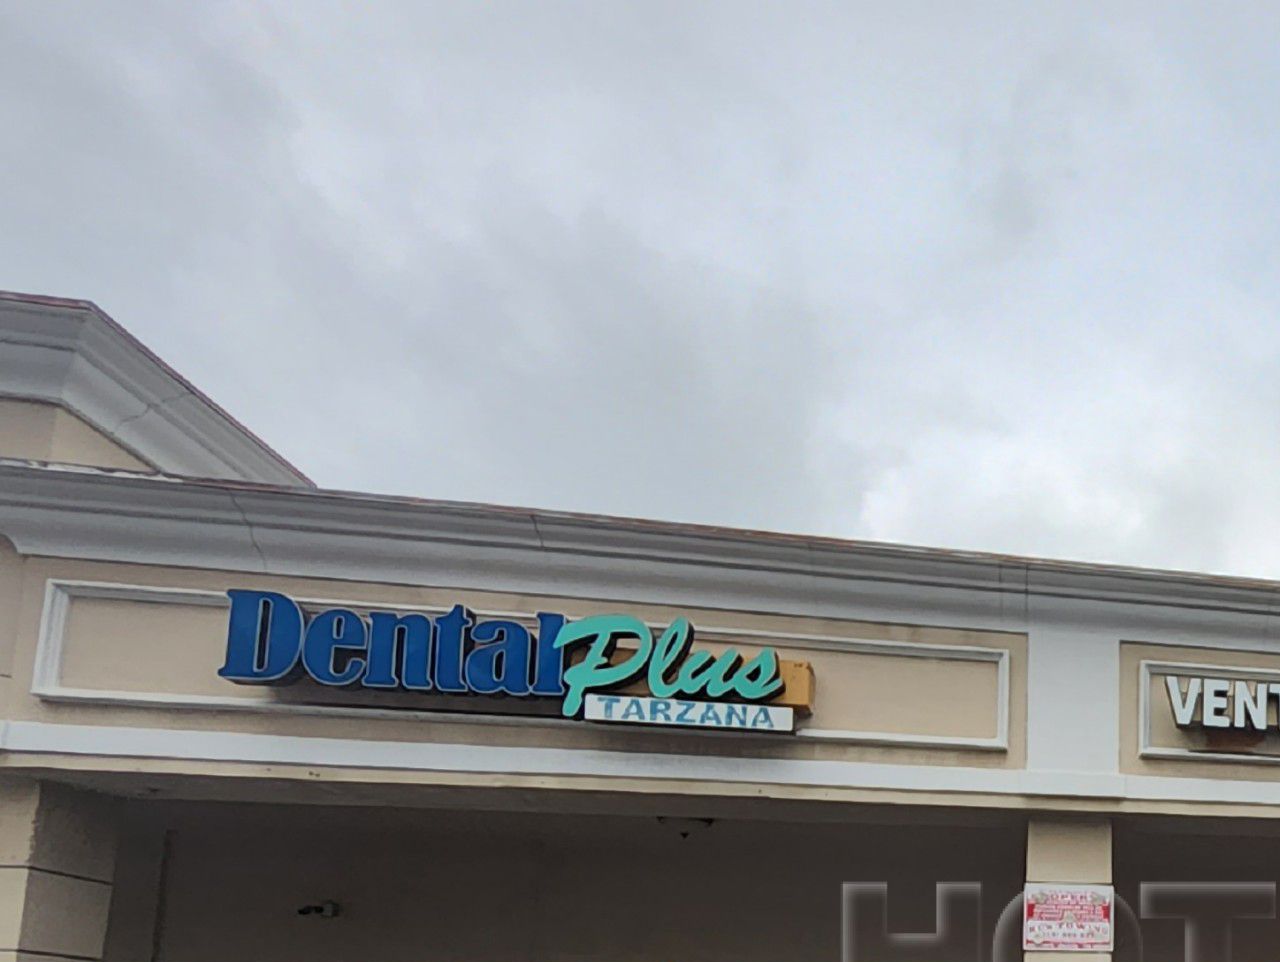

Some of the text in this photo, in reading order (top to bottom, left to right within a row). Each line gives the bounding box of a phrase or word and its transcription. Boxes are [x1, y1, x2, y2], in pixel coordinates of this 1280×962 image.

[217, 589, 787, 718] Dental Plus
[597, 696, 775, 730] TARZANA
